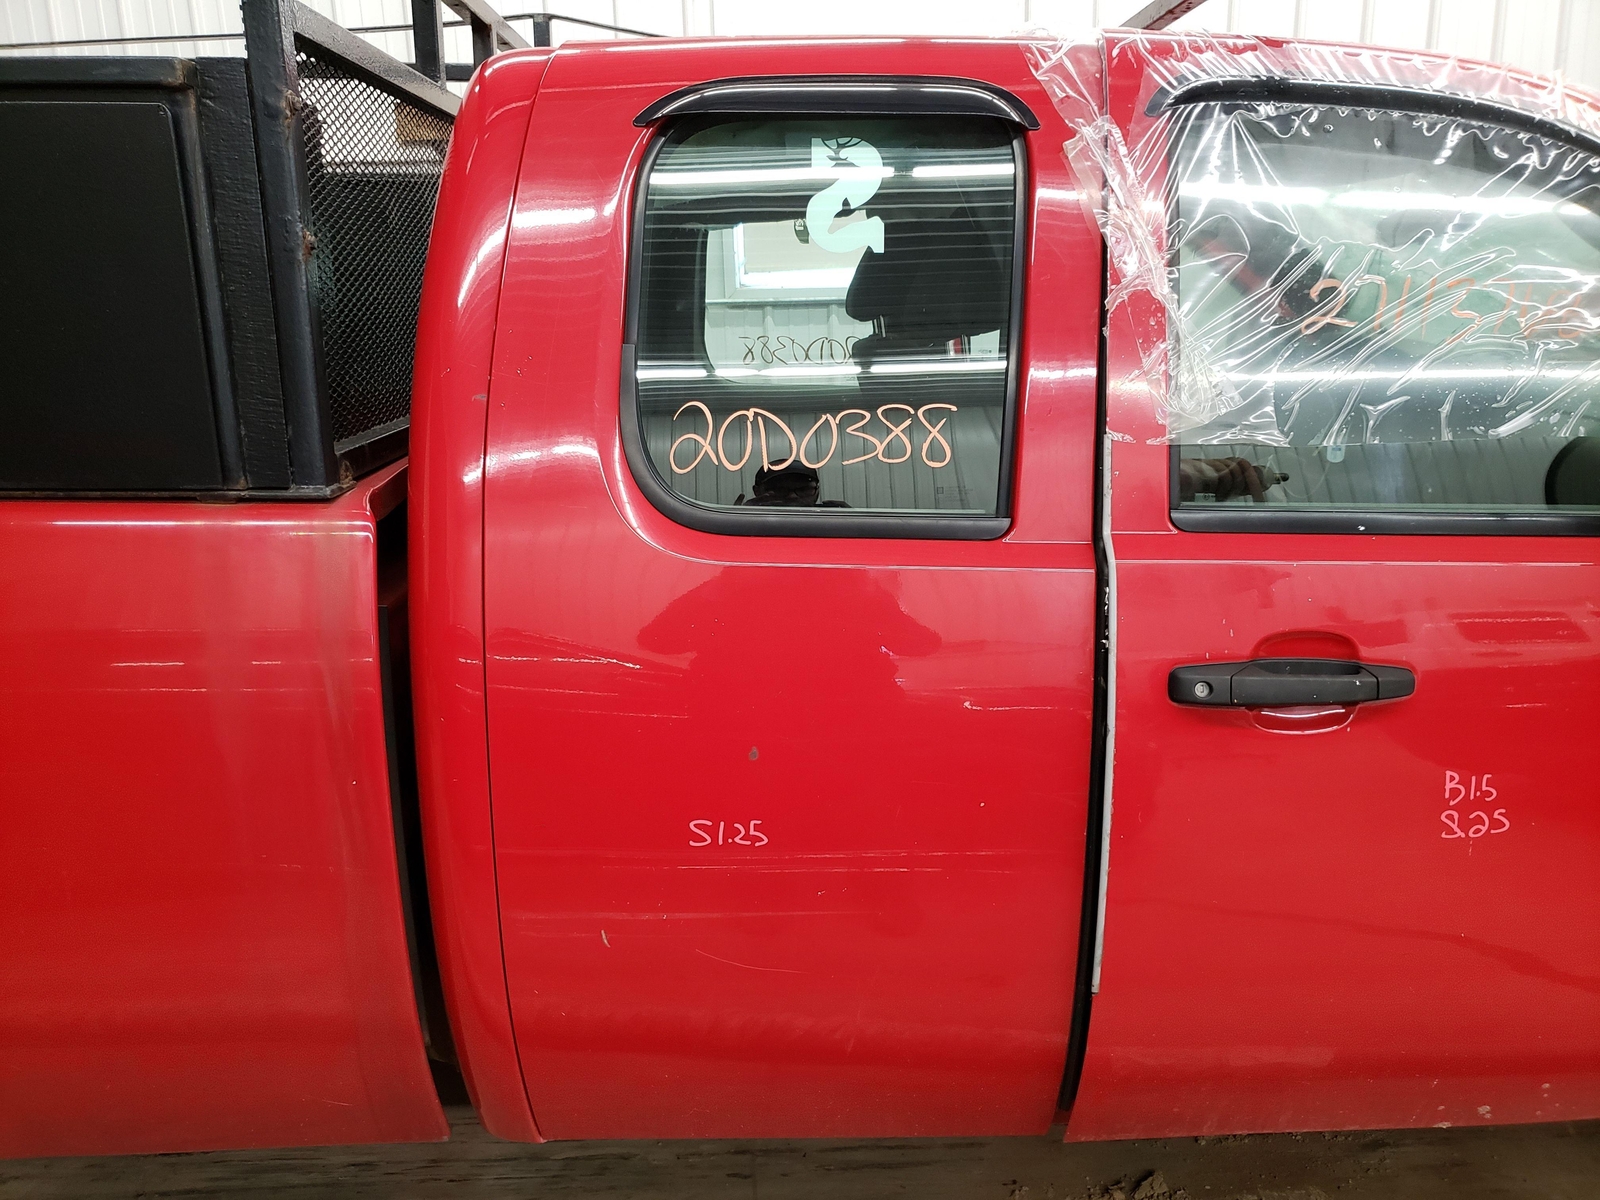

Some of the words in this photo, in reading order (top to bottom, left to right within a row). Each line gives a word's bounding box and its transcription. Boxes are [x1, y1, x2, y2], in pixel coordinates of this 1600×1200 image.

[669, 400, 958, 475] 20D0388
[1444, 769, 1498, 806] B1.5
[689, 819, 769, 847] S1.25
